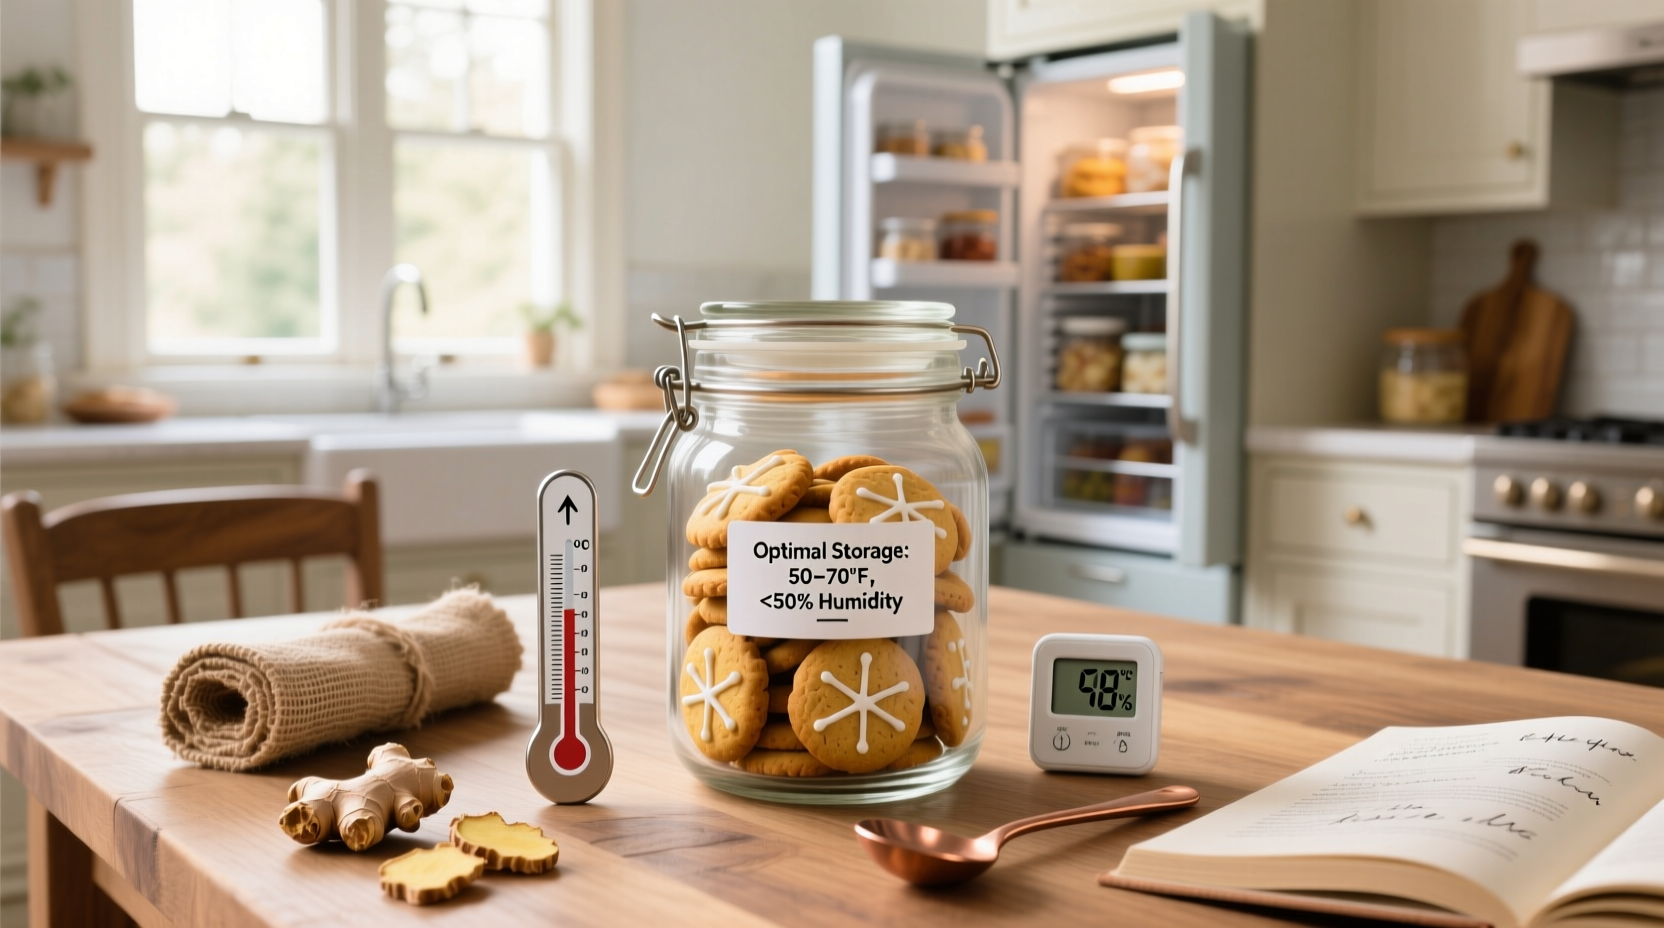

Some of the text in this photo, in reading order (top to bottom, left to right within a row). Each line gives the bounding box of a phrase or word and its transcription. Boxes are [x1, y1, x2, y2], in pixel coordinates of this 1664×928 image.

[753, 541, 909, 564] Optimal Storage:
[760, 591, 904, 615] <50% Humidity
